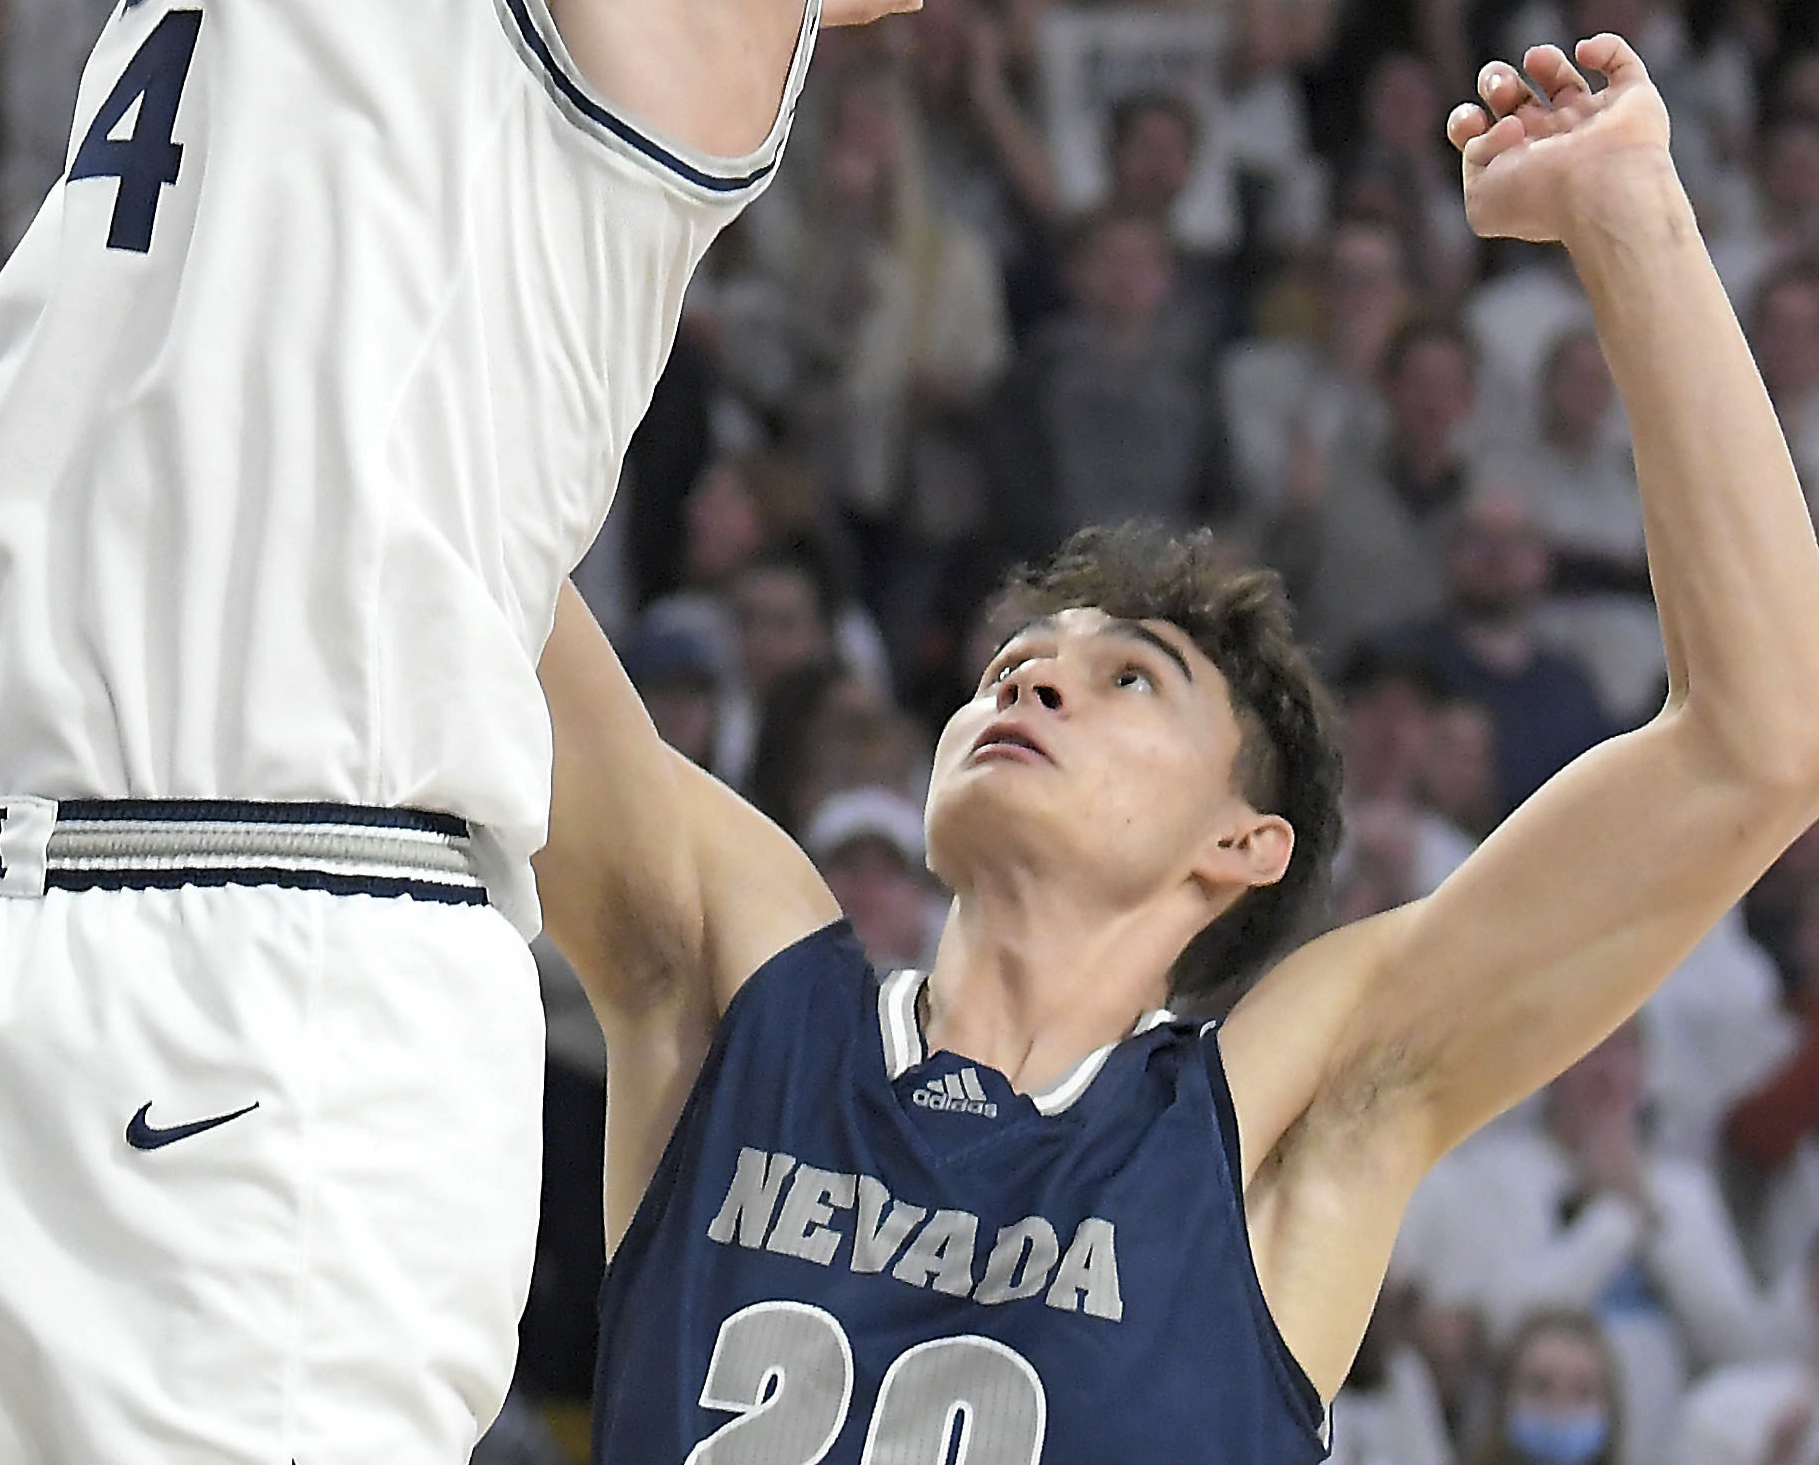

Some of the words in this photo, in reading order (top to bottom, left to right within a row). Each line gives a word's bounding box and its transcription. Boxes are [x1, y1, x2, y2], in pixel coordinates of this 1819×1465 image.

[66, 9, 204, 253] 4
[912, 1087, 997, 1119] adidas
[707, 1146, 1124, 1323] NEVADA
[683, 1300, 1047, 1465] 20
